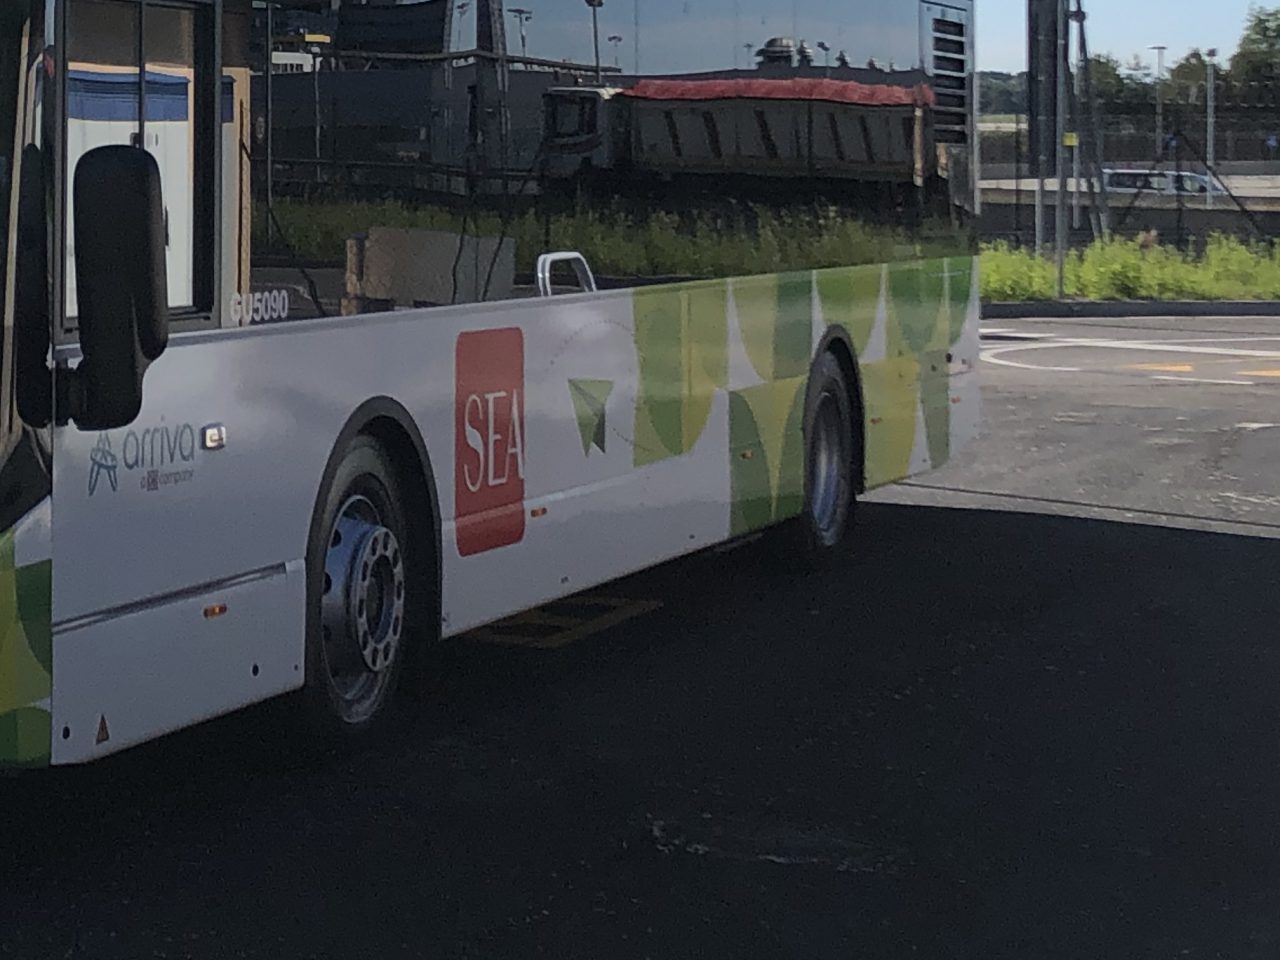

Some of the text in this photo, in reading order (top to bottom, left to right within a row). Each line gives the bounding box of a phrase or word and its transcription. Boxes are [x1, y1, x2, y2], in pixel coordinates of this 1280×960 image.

[230, 290, 288, 326] GU5090
[123, 415, 195, 470] arriva
[464, 389, 525, 492] SEA
